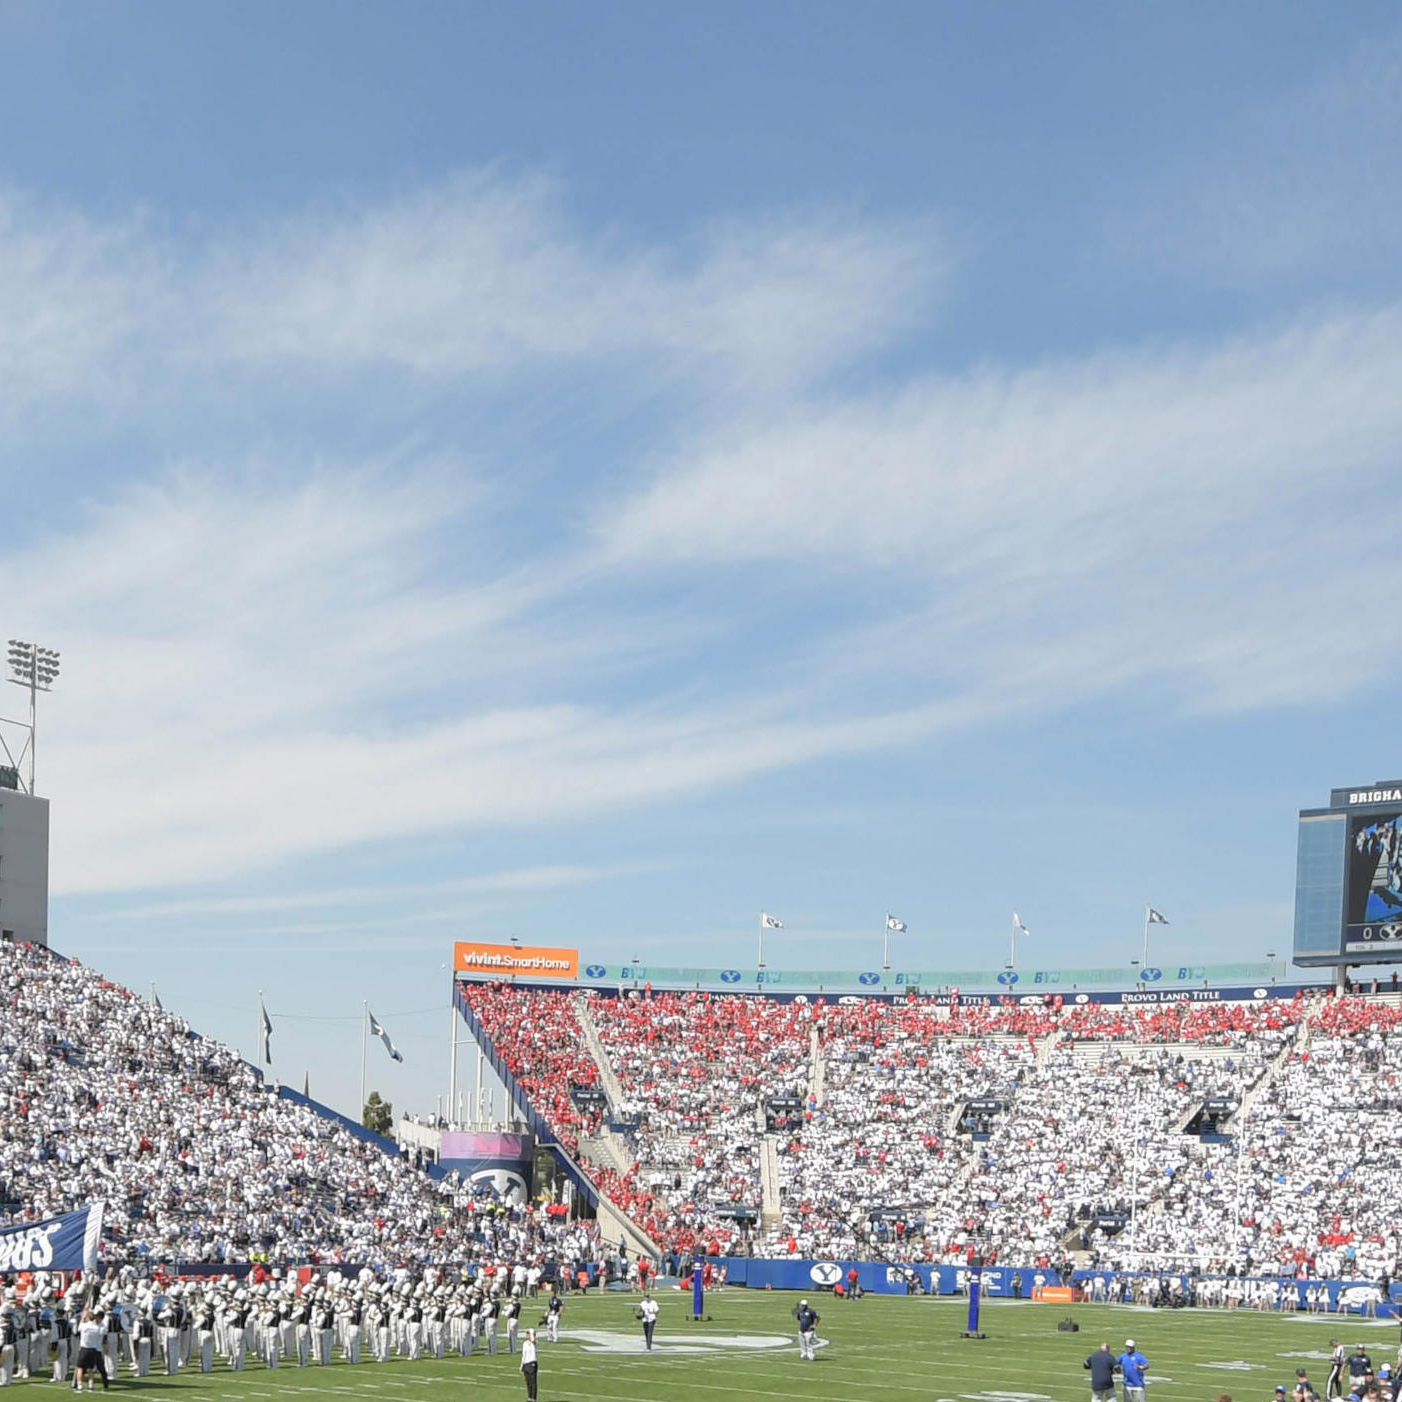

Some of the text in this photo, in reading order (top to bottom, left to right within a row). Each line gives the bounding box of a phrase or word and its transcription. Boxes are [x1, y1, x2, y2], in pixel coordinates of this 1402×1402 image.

[1363, 927, 1372, 941] 0
[463, 952, 571, 969] vivint.SmartHome
[1193, 990, 1221, 1001] TITLE
